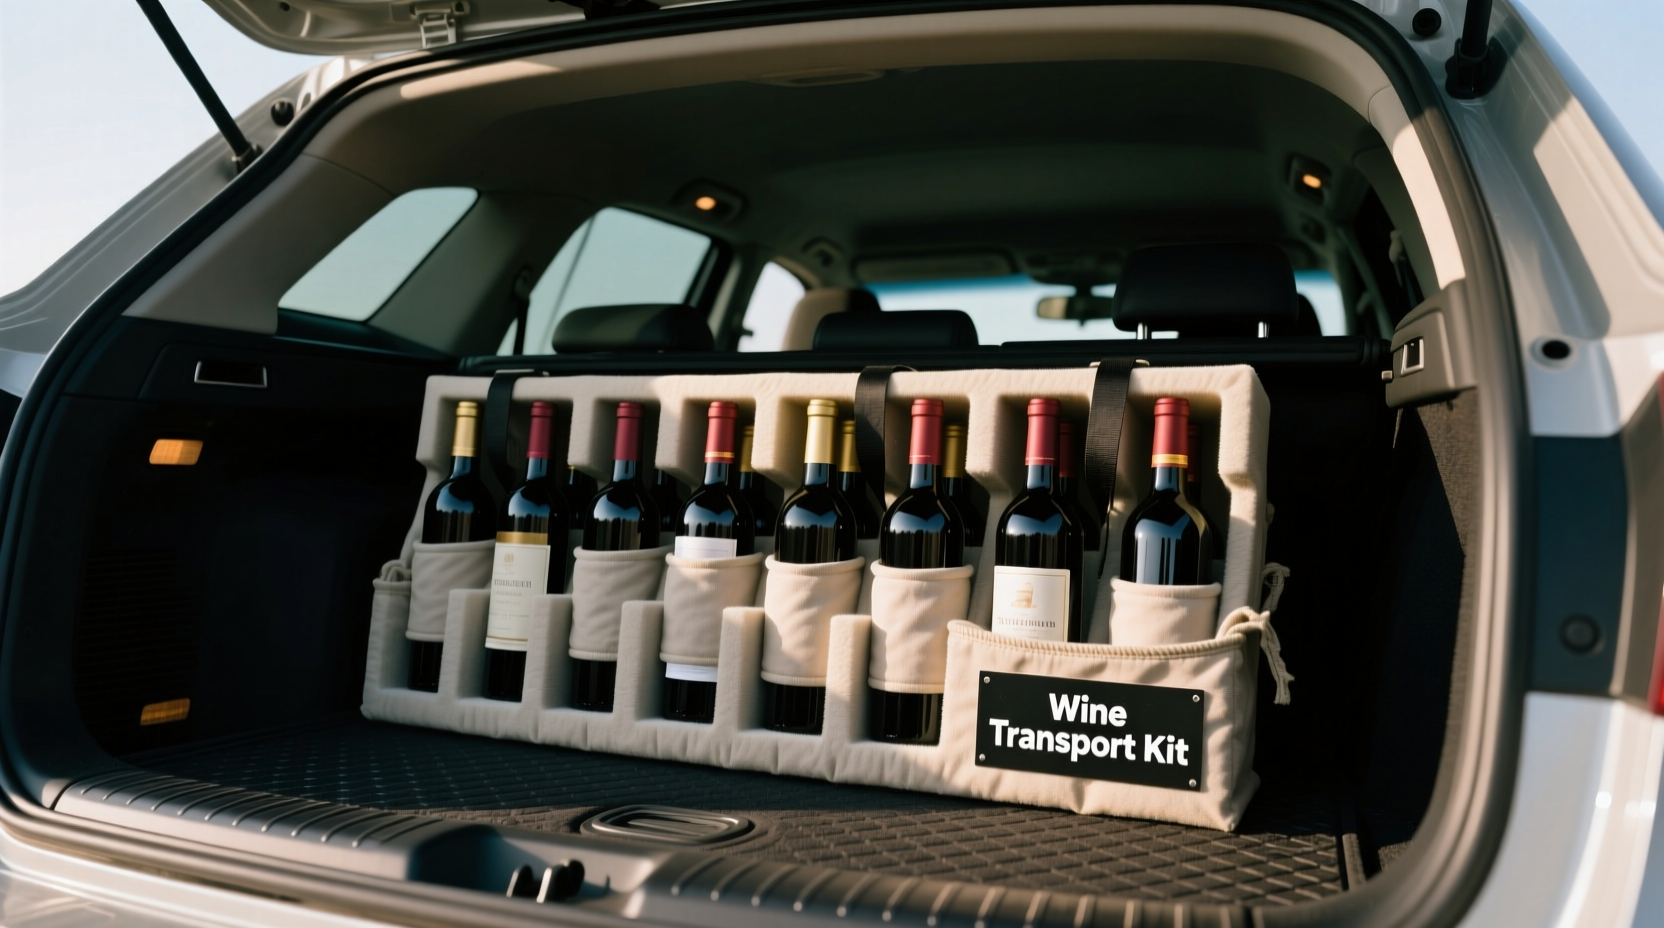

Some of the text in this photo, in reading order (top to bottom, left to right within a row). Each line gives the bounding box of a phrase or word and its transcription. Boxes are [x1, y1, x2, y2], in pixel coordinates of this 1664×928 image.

[1048, 692, 1128, 728] Wine
[988, 717, 1190, 767] Transport Kit
